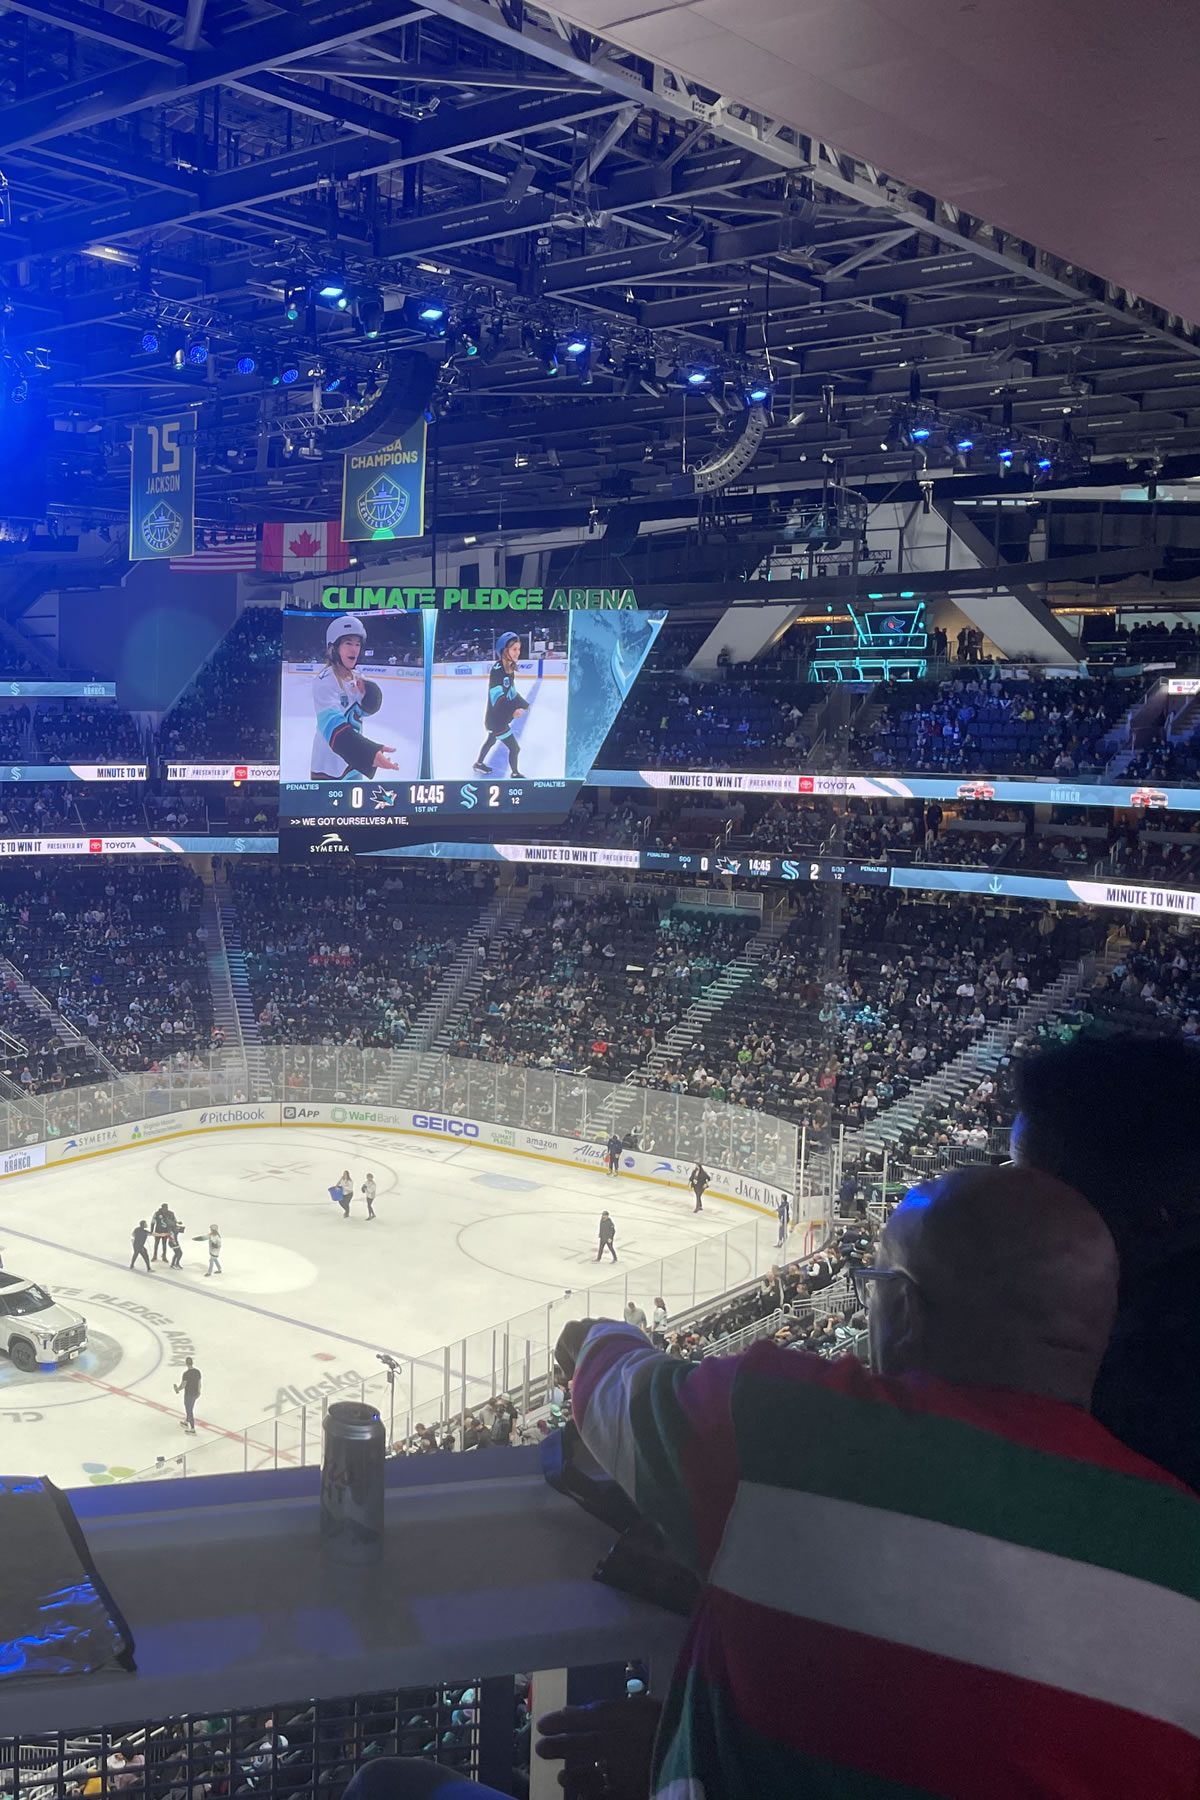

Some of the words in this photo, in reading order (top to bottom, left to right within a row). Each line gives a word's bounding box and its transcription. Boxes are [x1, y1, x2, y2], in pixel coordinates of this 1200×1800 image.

[147, 422, 181, 473] 15
[351, 450, 418, 470] CHAMPIONS
[146, 474, 180, 495] JACKSON
[322, 587, 436, 610] CLIMATE
[444, 587, 543, 610] PLEDGE
[551, 588, 639, 611] ARENA
[97, 767, 125, 778] MINUTE
[126, 767, 136, 778] TO
[178, 767, 187, 778] IT
[668, 774, 700, 787] MINUTE
[702, 775, 713, 787] TO
[715, 775, 733, 788] WIN
[734, 776, 743, 788] IT
[818, 781, 856, 790] TOYOTA
[328, 790, 343, 798] SOG
[351, 787, 363, 809] 0
[409, 785, 445, 804] 14:45
[489, 786, 500, 807] 2
[511, 797, 520, 805] 12
[302, 818, 316, 826] WE
[317, 818, 336, 826] GOT
[336, 817, 386, 826] OURSELVES
[386, 818, 394, 826] A
[394, 817, 409, 827] TIE,
[7, 842, 16, 853] TO
[17, 841, 33, 853] WIN
[34, 841, 42, 852] IT
[47, 842, 75, 850] PRESENTED
[310, 844, 350, 853] SYMETRA
[525, 848, 558, 861] MINUTE
[560, 849, 570, 861] TO
[572, 850, 588, 862] WIN
[589, 851, 597, 863] IT
[700, 857, 708, 871] 0
[749, 859, 771, 872] 14:45
[810, 863, 819, 880] 2
[1106, 888, 1148, 905] MINUTE
[1150, 891, 1164, 906] TO
[1166, 893, 1185, 909] WIN
[1186, 896, 1196, 910] IT
[209, 1108, 264, 1123] PitchBook
[349, 1111, 377, 1122] WaFd
[377, 1112, 400, 1124] Bank
[412, 1114, 480, 1138] GEICO
[79, 1131, 118, 1146] SYMETRA
[526, 1137, 558, 1149] amazon
[573, 1144, 608, 1159] Alask
[4, 1156, 31, 1173] KRAKEN
[677, 1165, 731, 1186] SYTRA
[735, 1179, 760, 1202] JACK
[89, 1293, 175, 1326] PLEDGE
[263, 1369, 366, 1416] Alaska
